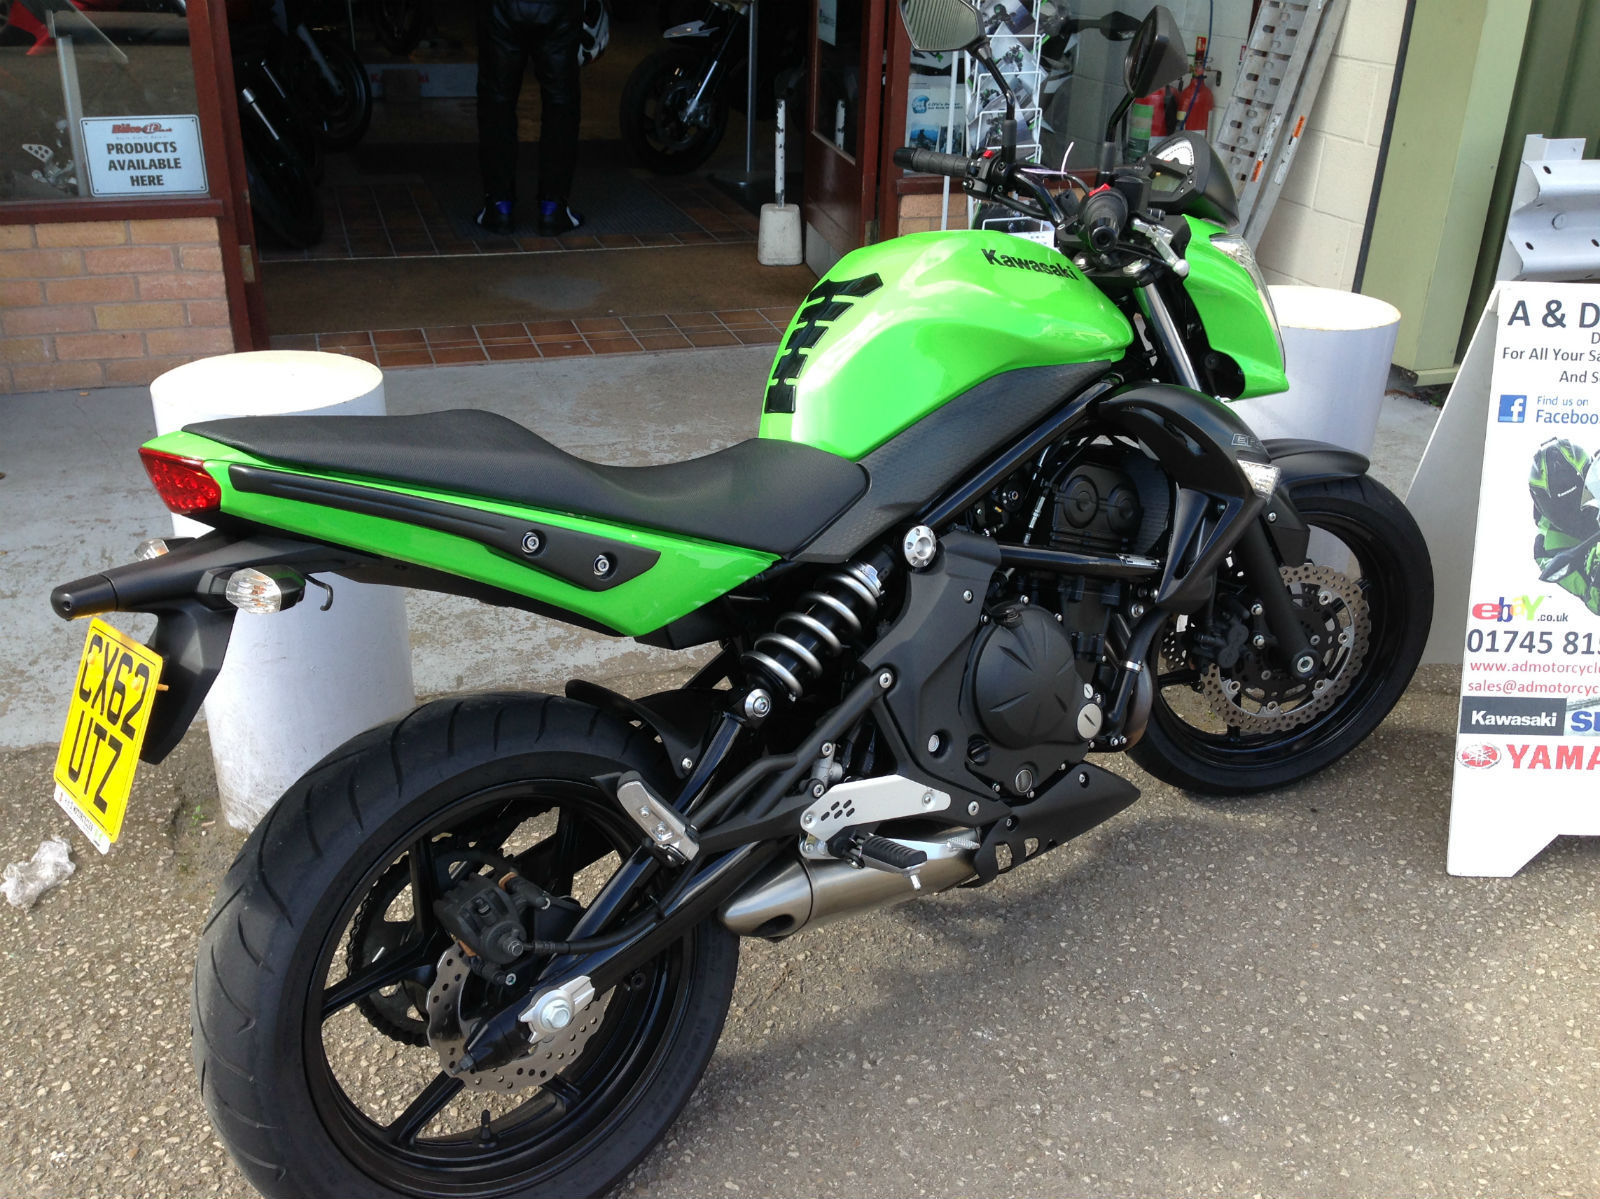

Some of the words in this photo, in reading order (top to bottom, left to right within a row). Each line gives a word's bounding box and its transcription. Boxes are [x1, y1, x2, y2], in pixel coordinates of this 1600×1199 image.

[106, 141, 178, 155] PRODUCTS
[108, 157, 182, 171] AVAILABLE
[130, 174, 165, 187] HERE
[981, 248, 1080, 281] Kawasaki
[1507, 300, 1531, 326] A
[1542, 299, 1567, 329] &
[1579, 302, 1600, 328] D
[1502, 347, 1526, 360] For
[1529, 347, 1549, 361] All
[1553, 348, 1585, 362] Your
[1559, 370, 1588, 383] And
[1591, 371, 1600, 384] S
[1536, 395, 1559, 406] Find
[1562, 398, 1574, 407] us
[1576, 398, 1589, 407] on
[1535, 409, 1600, 425] Faceboo
[1467, 628, 1553, 654] 01745
[1563, 631, 1600, 655] 81
[1470, 660, 1600, 677] www.admotorcycl
[79, 633, 150, 741] CX62
[1471, 710, 1558, 727] Kawasaki
[1571, 710, 1600, 732] S
[68, 709, 123, 815] UTZ
[1506, 743, 1600, 770] YAMA
